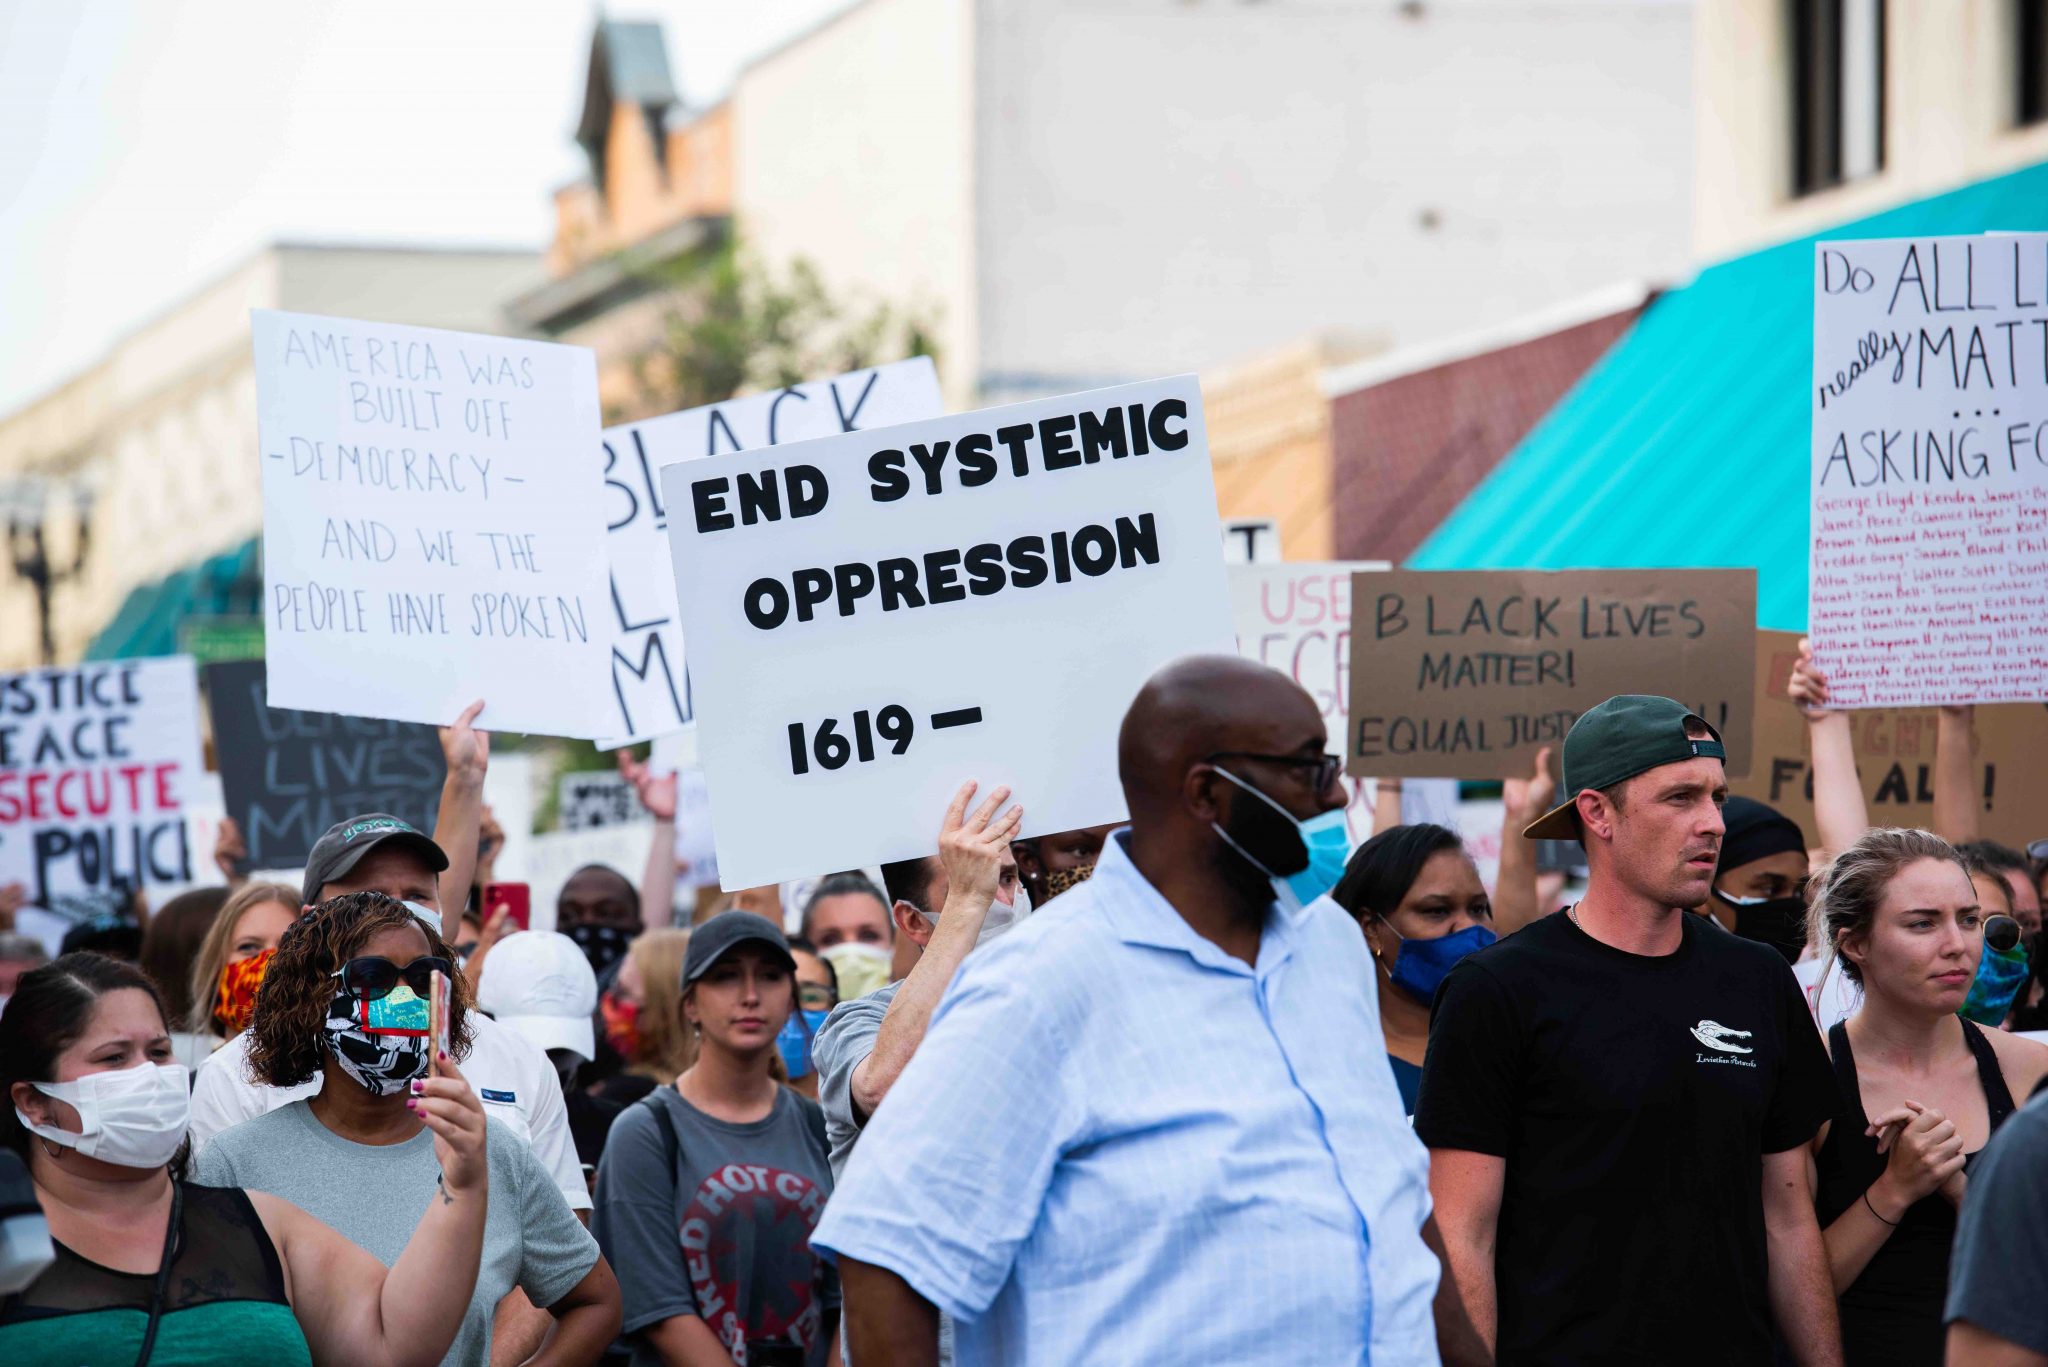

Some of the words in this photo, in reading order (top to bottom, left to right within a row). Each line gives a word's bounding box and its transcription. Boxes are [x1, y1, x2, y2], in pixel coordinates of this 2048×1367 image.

[1823, 249, 1875, 295] Do
[1888, 242, 1997, 316] ALL
[284, 328, 443, 382] AMERICA
[459, 350, 535, 390] WAS
[1819, 330, 1913, 410] really
[351, 382, 443, 431] BUILT
[465, 398, 513, 441] OFF
[691, 464, 829, 534] END
[867, 398, 1189, 503] SYSTEMIC
[1820, 427, 1990, 488] ASKING
[321, 518, 398, 564] AND
[416, 527, 460, 567] WE
[475, 532, 543, 574] THE
[743, 512, 1160, 631] OPPRESSION
[274, 581, 369, 634] PEOPLE
[388, 593, 451, 637] HAVE
[471, 592, 588, 644] SPOKEN
[1376, 592, 1559, 640] BLACK
[1581, 595, 1705, 640] LIVES
[1417, 648, 1576, 692] MATTER!
[1355, 714, 1493, 758] EQUAL
[1503, 709, 1577, 750] JUST
[266, 740, 442, 796] LIVES
[696, 1164, 768, 1217] HOT
[678, 1216, 727, 1320] RED
